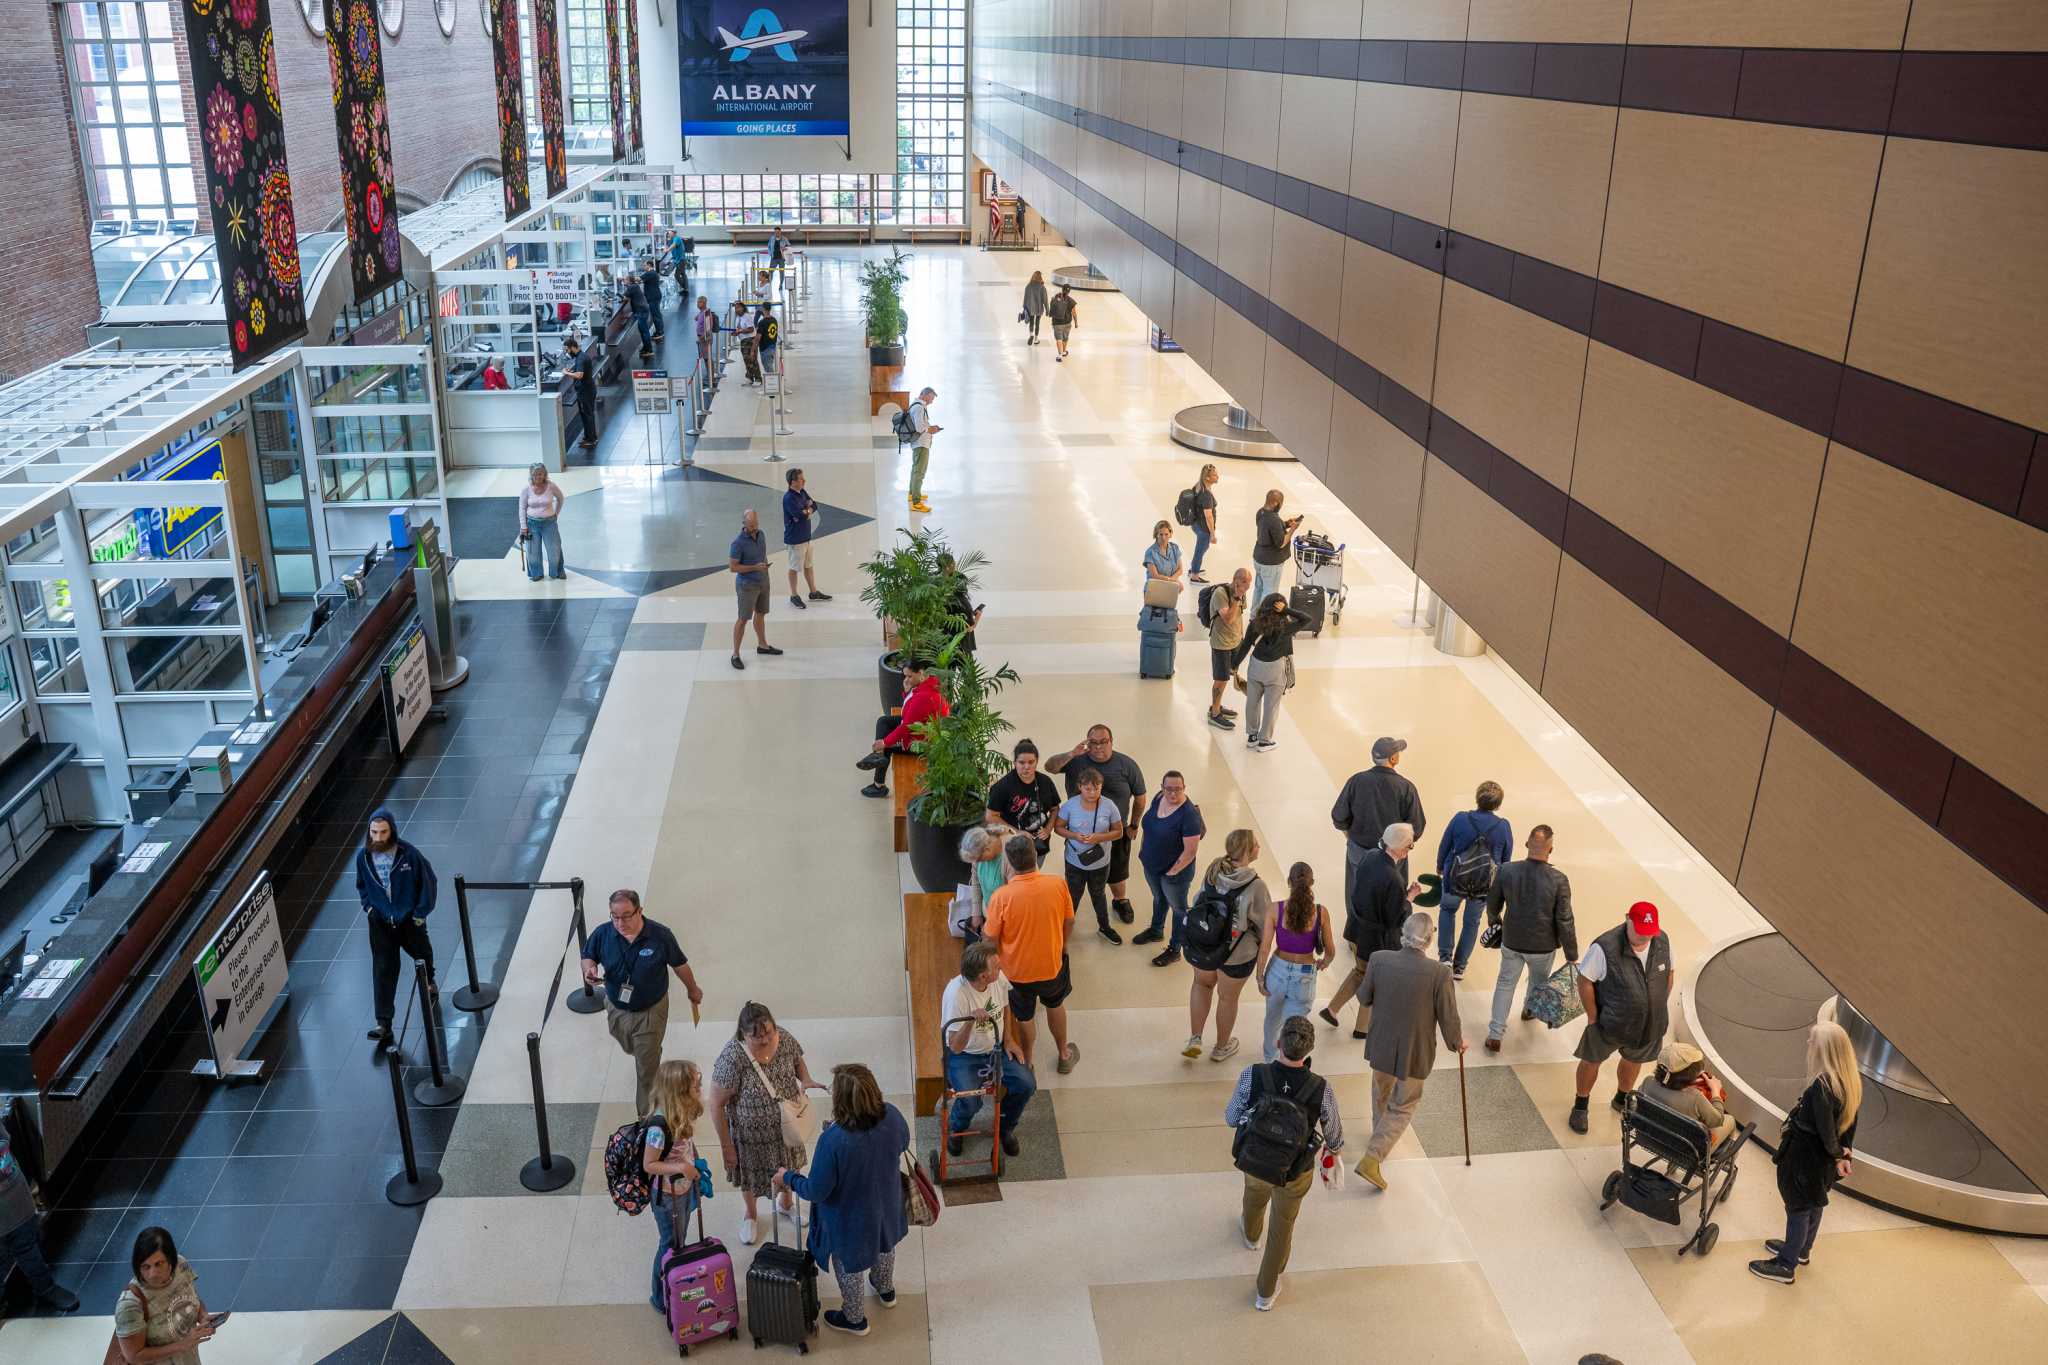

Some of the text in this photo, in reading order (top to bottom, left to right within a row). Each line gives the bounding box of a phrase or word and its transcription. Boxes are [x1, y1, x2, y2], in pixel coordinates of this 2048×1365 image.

[712, 84, 817, 100] ALBANY
[716, 102, 814, 112] INTERNATIONAL AIRPORT
[736, 123, 797, 133] GOING PLACES
[545, 292, 554, 300] TO
[555, 292, 577, 300] BOOTH
[202, 881, 271, 973] enterprise
[227, 944, 249, 977] Please
[247, 911, 271, 948] Proceed
[231, 963, 249, 993] to the
[234, 939, 280, 1008] Enterprise Booth
[238, 981, 265, 1025] in Garage
